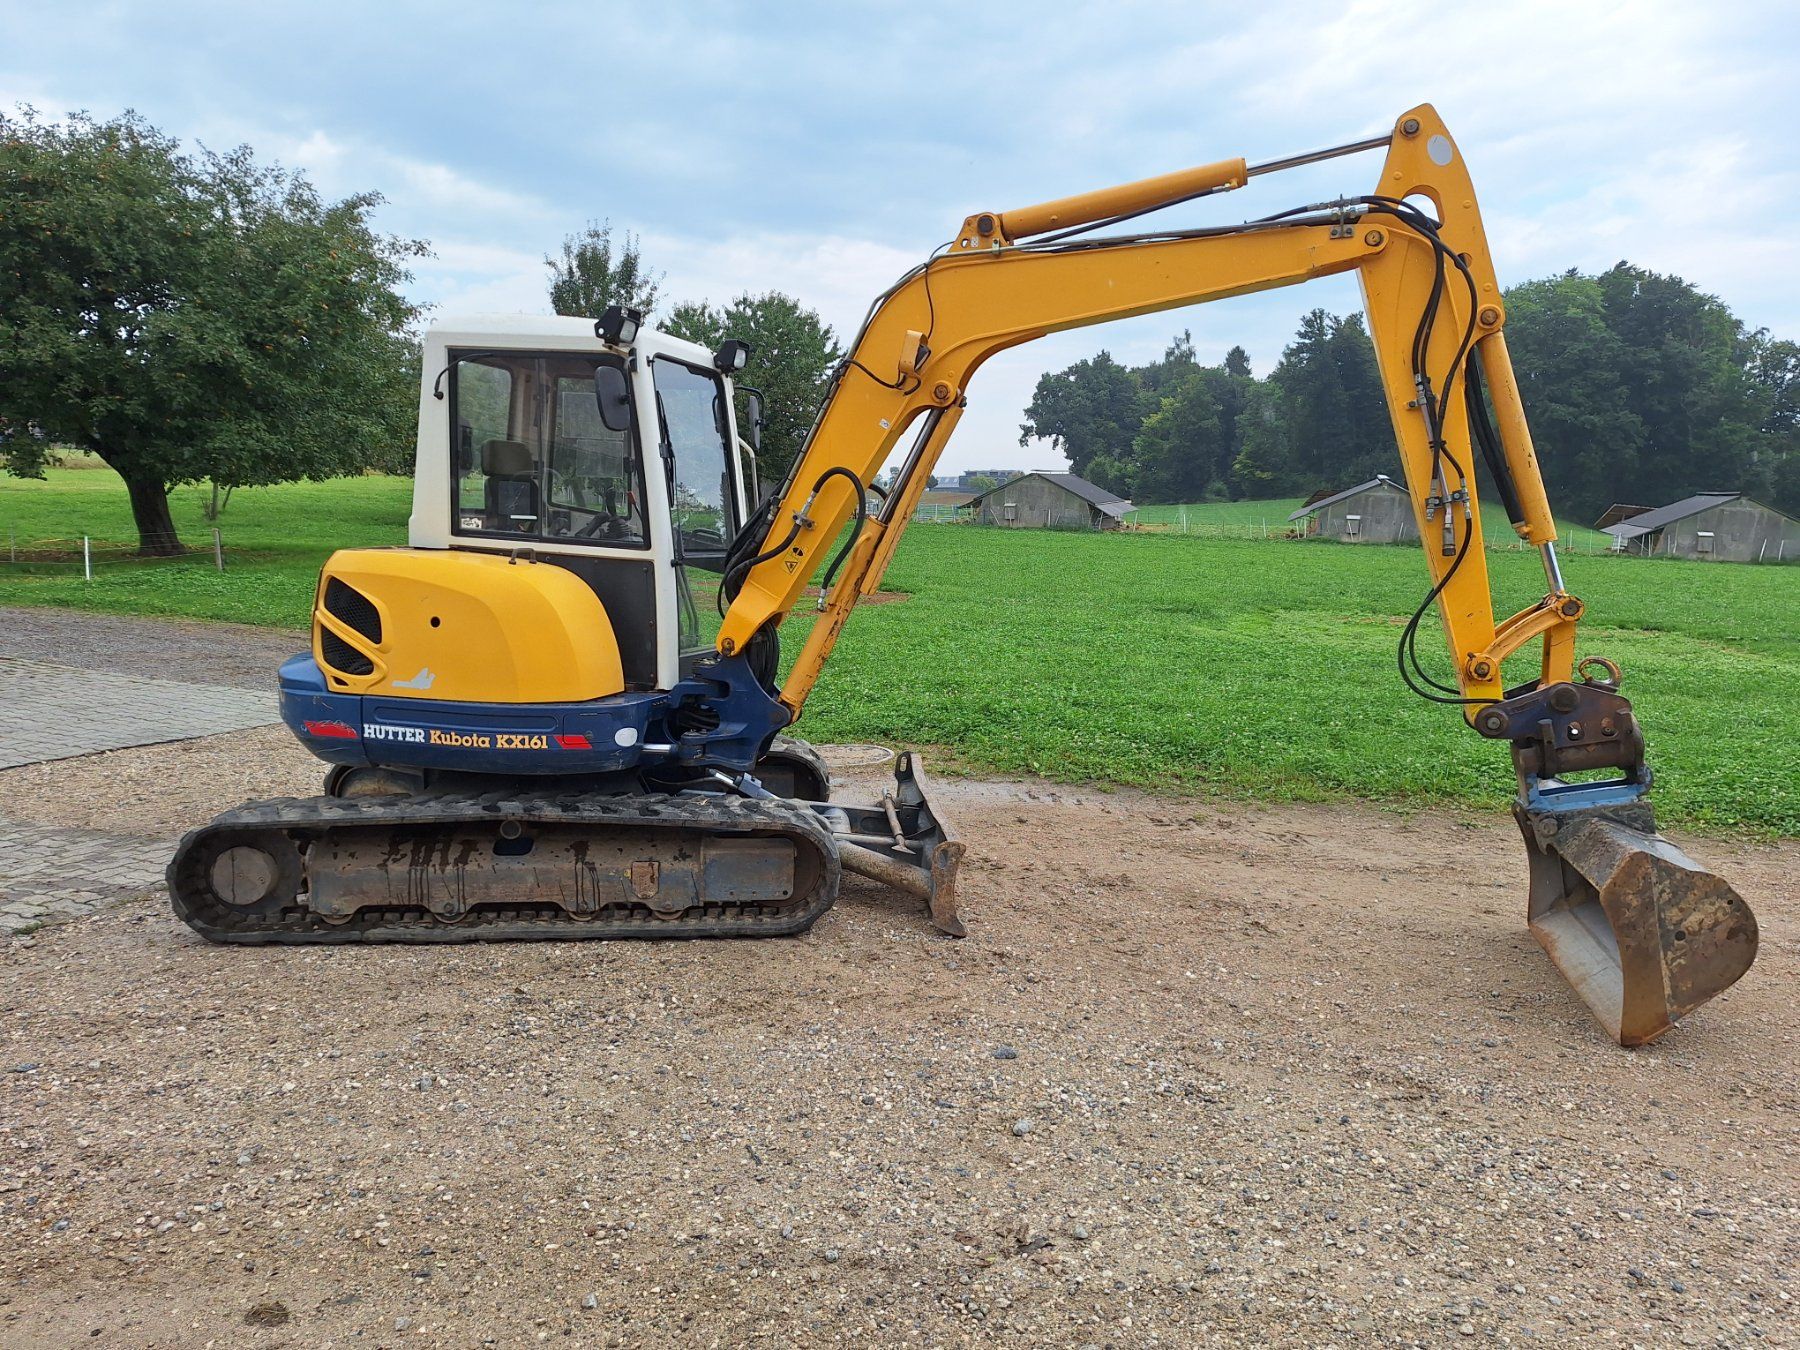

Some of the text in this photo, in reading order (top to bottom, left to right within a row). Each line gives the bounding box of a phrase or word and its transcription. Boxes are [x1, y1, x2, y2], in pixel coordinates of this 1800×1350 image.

[363, 724, 548, 749] HUTTER Kubota KX161
